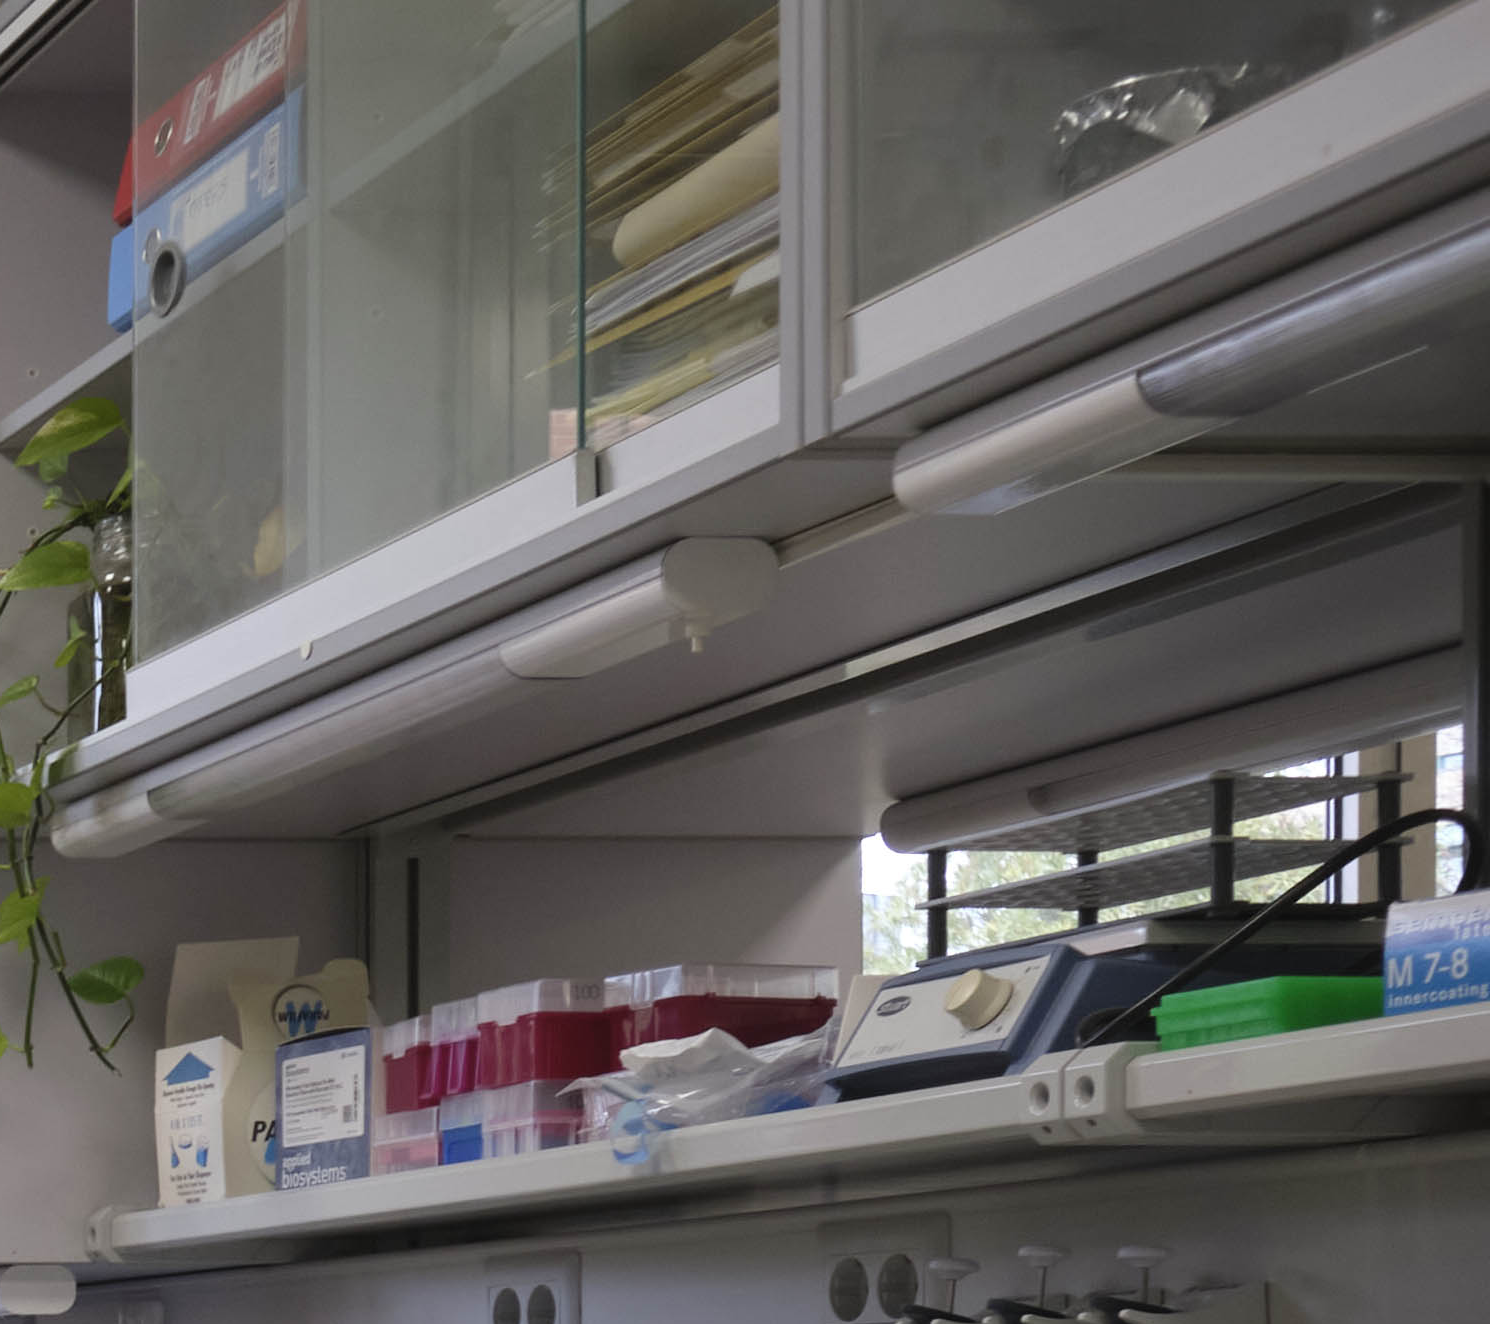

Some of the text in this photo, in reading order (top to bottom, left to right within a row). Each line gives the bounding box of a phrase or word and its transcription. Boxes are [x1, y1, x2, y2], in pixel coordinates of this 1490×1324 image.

[1388, 948, 1469, 989] M 7-8
[1388, 983, 1489, 1009] innercoating
[282, 1152, 312, 1171] applied
[282, 1165, 347, 1190] biosystems
